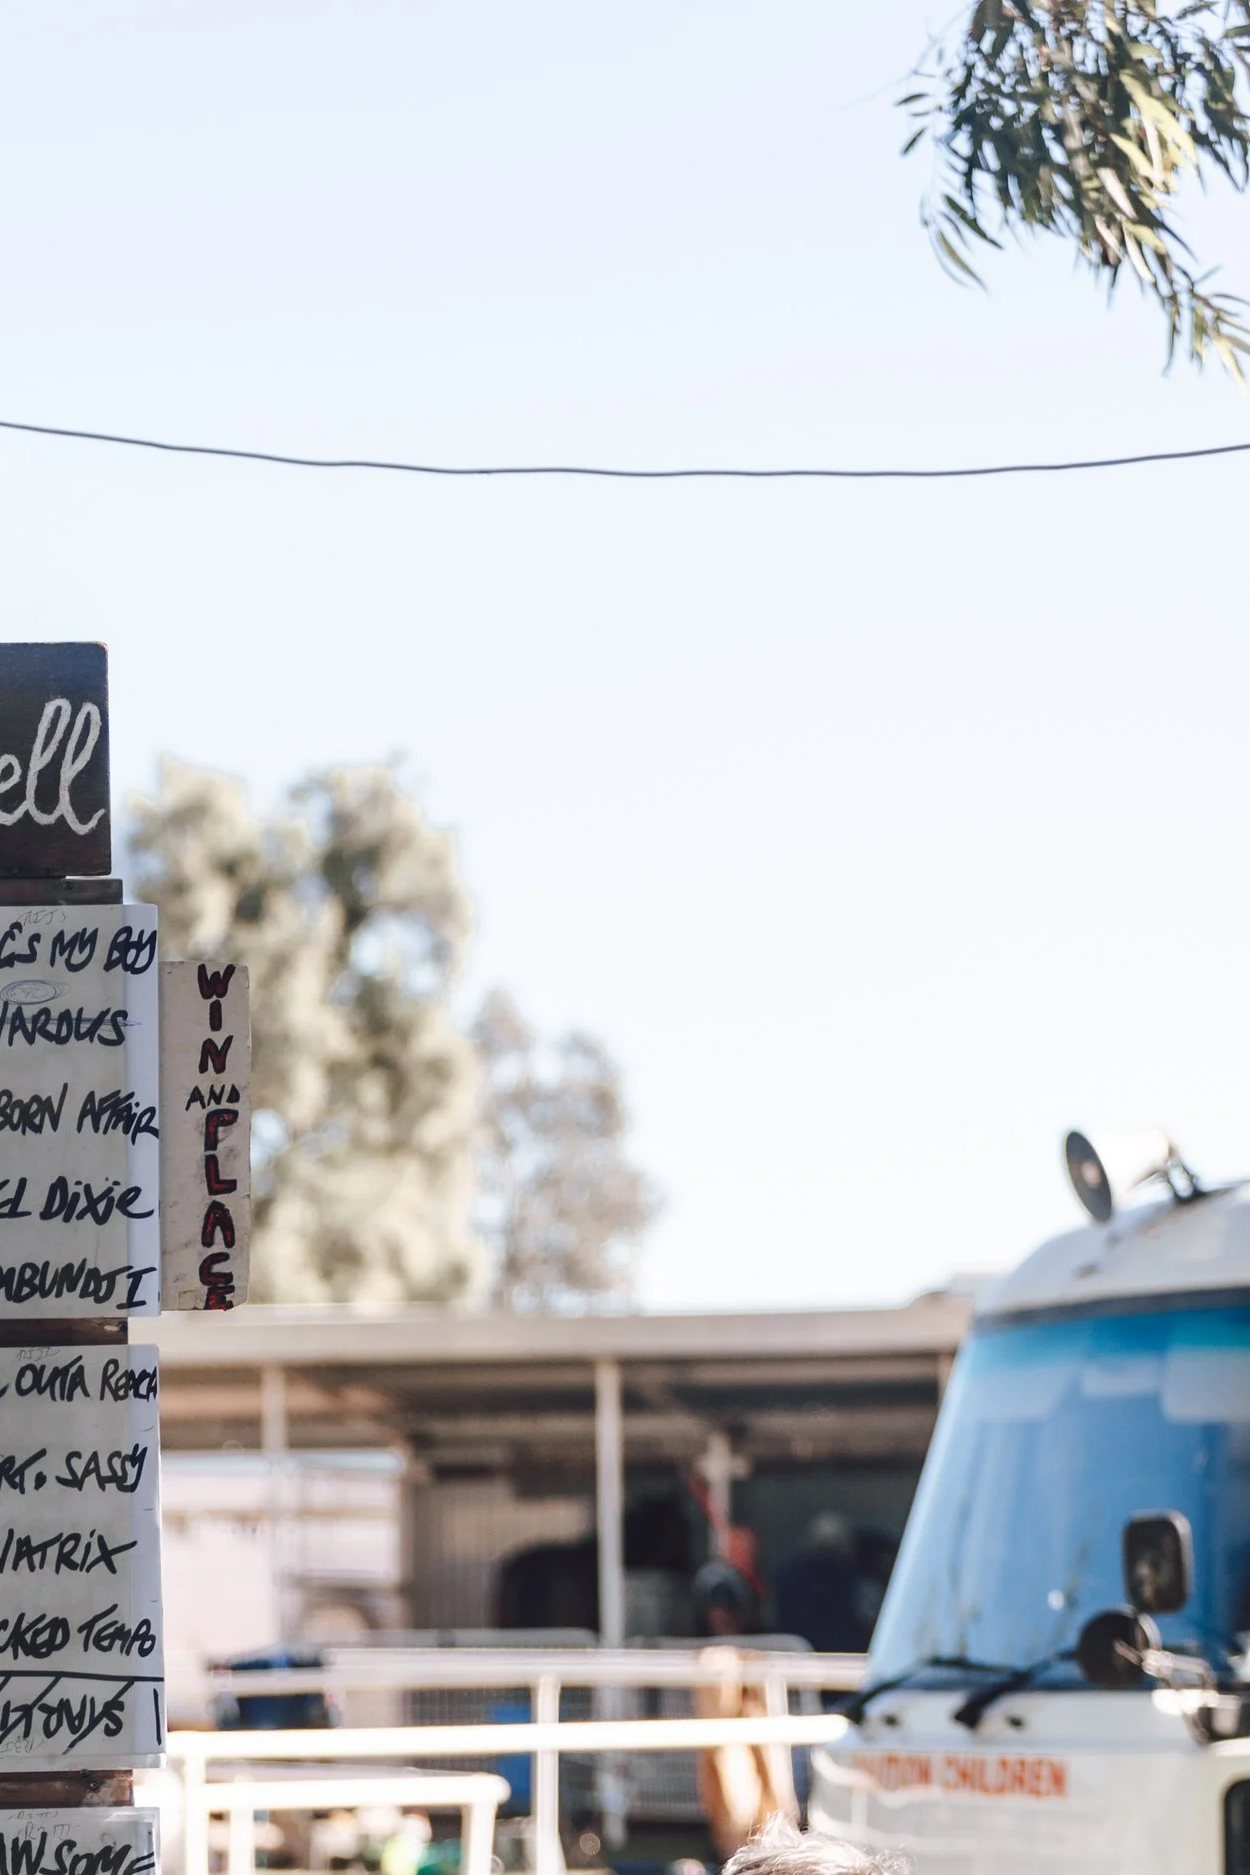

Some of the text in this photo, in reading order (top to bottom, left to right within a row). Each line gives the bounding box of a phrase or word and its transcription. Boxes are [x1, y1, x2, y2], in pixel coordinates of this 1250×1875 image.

[49, 926, 100, 973] MY
[103, 925, 158, 975] BOY
[197, 963, 236, 1075] WIN
[184, 1083, 242, 1111] AND
[198, 1109, 239, 1312] PLACE
[942, 1754, 1068, 1799] CHILDREN
